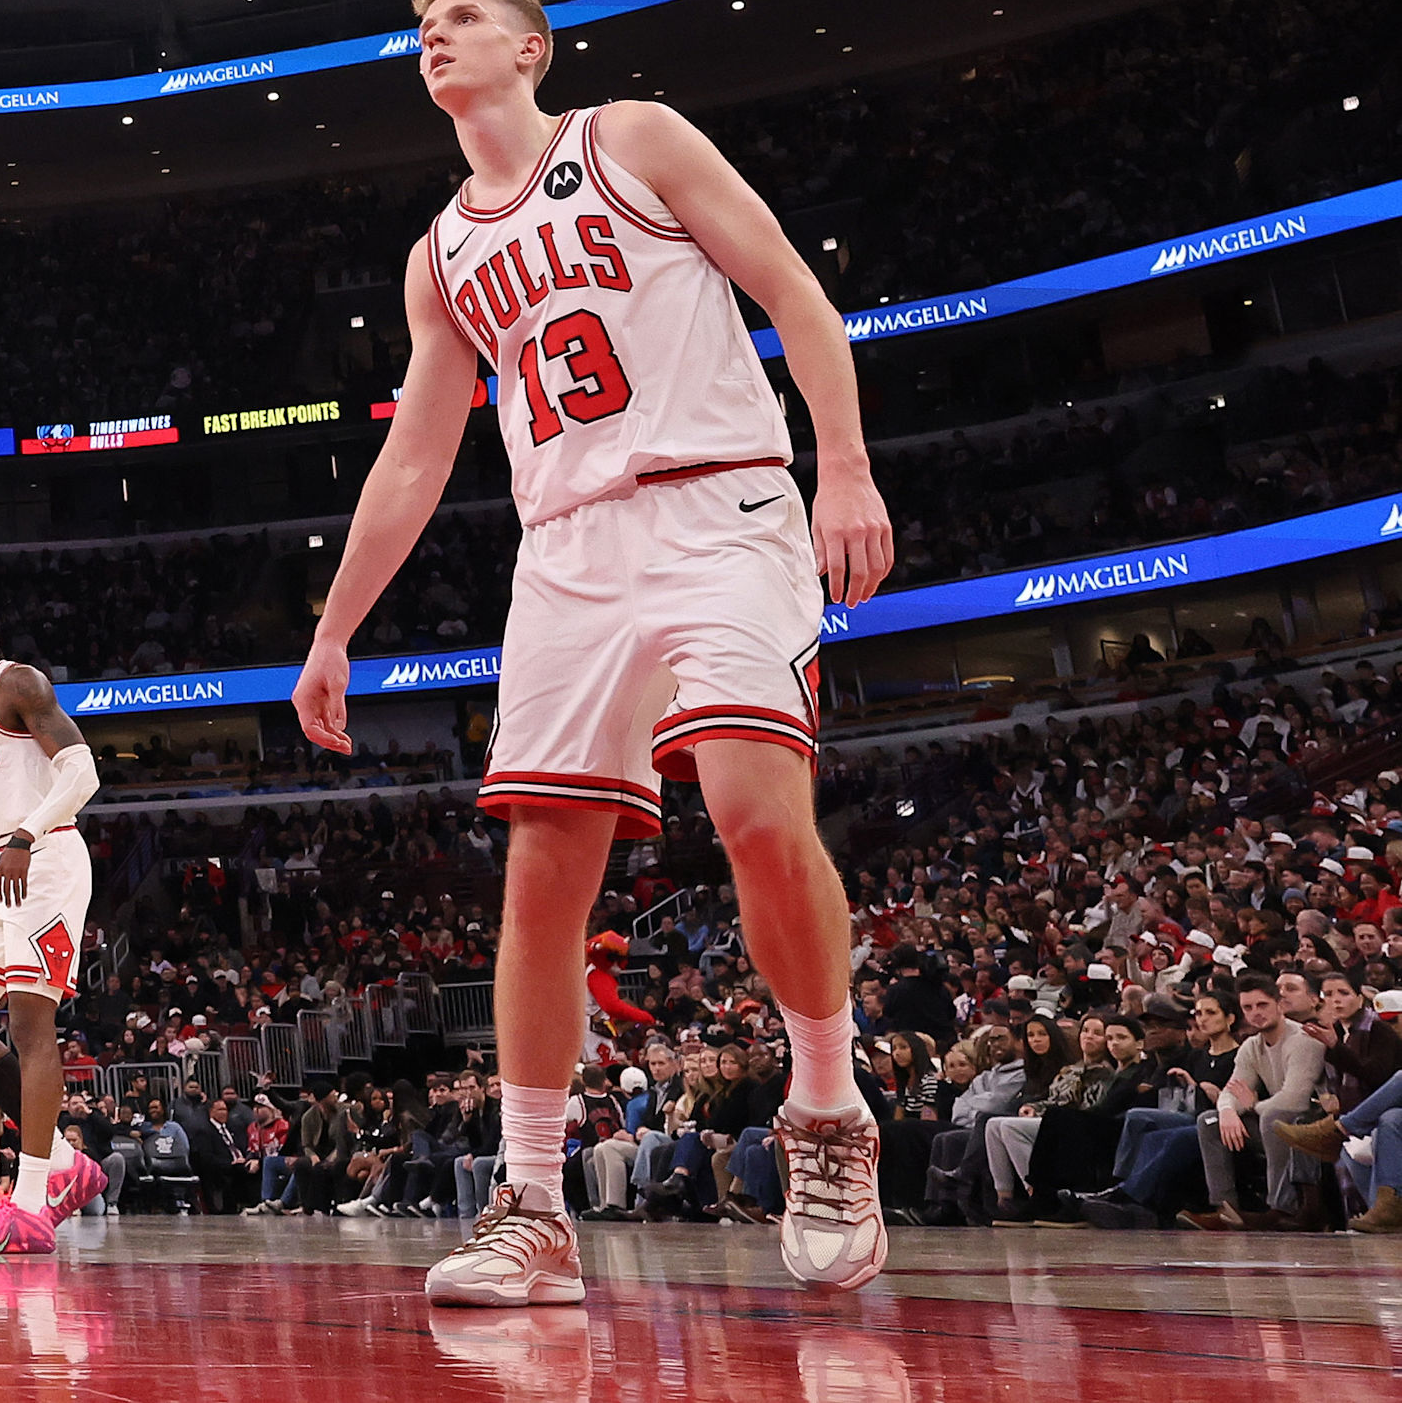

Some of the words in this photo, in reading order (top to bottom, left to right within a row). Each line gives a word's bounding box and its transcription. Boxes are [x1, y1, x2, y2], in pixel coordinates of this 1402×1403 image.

[189, 59, 273, 86] MAGELLAN
[1189, 215, 1306, 263] MAGELLAN
[455, 214, 634, 367] BULLS
[873, 296, 988, 335] MAGELLAN
[518, 307, 634, 448] 13
[89, 414, 171, 437] TIMBERWOLVES
[204, 413, 238, 434] FAST
[239, 408, 286, 431] BREAK
[286, 401, 340, 426] POINTS
[89, 433, 124, 450] BULLS
[1057, 553, 1188, 598] MAGELLAN
[422, 655, 500, 682] MAGELL
[114, 680, 224, 706] MAGELLAN
